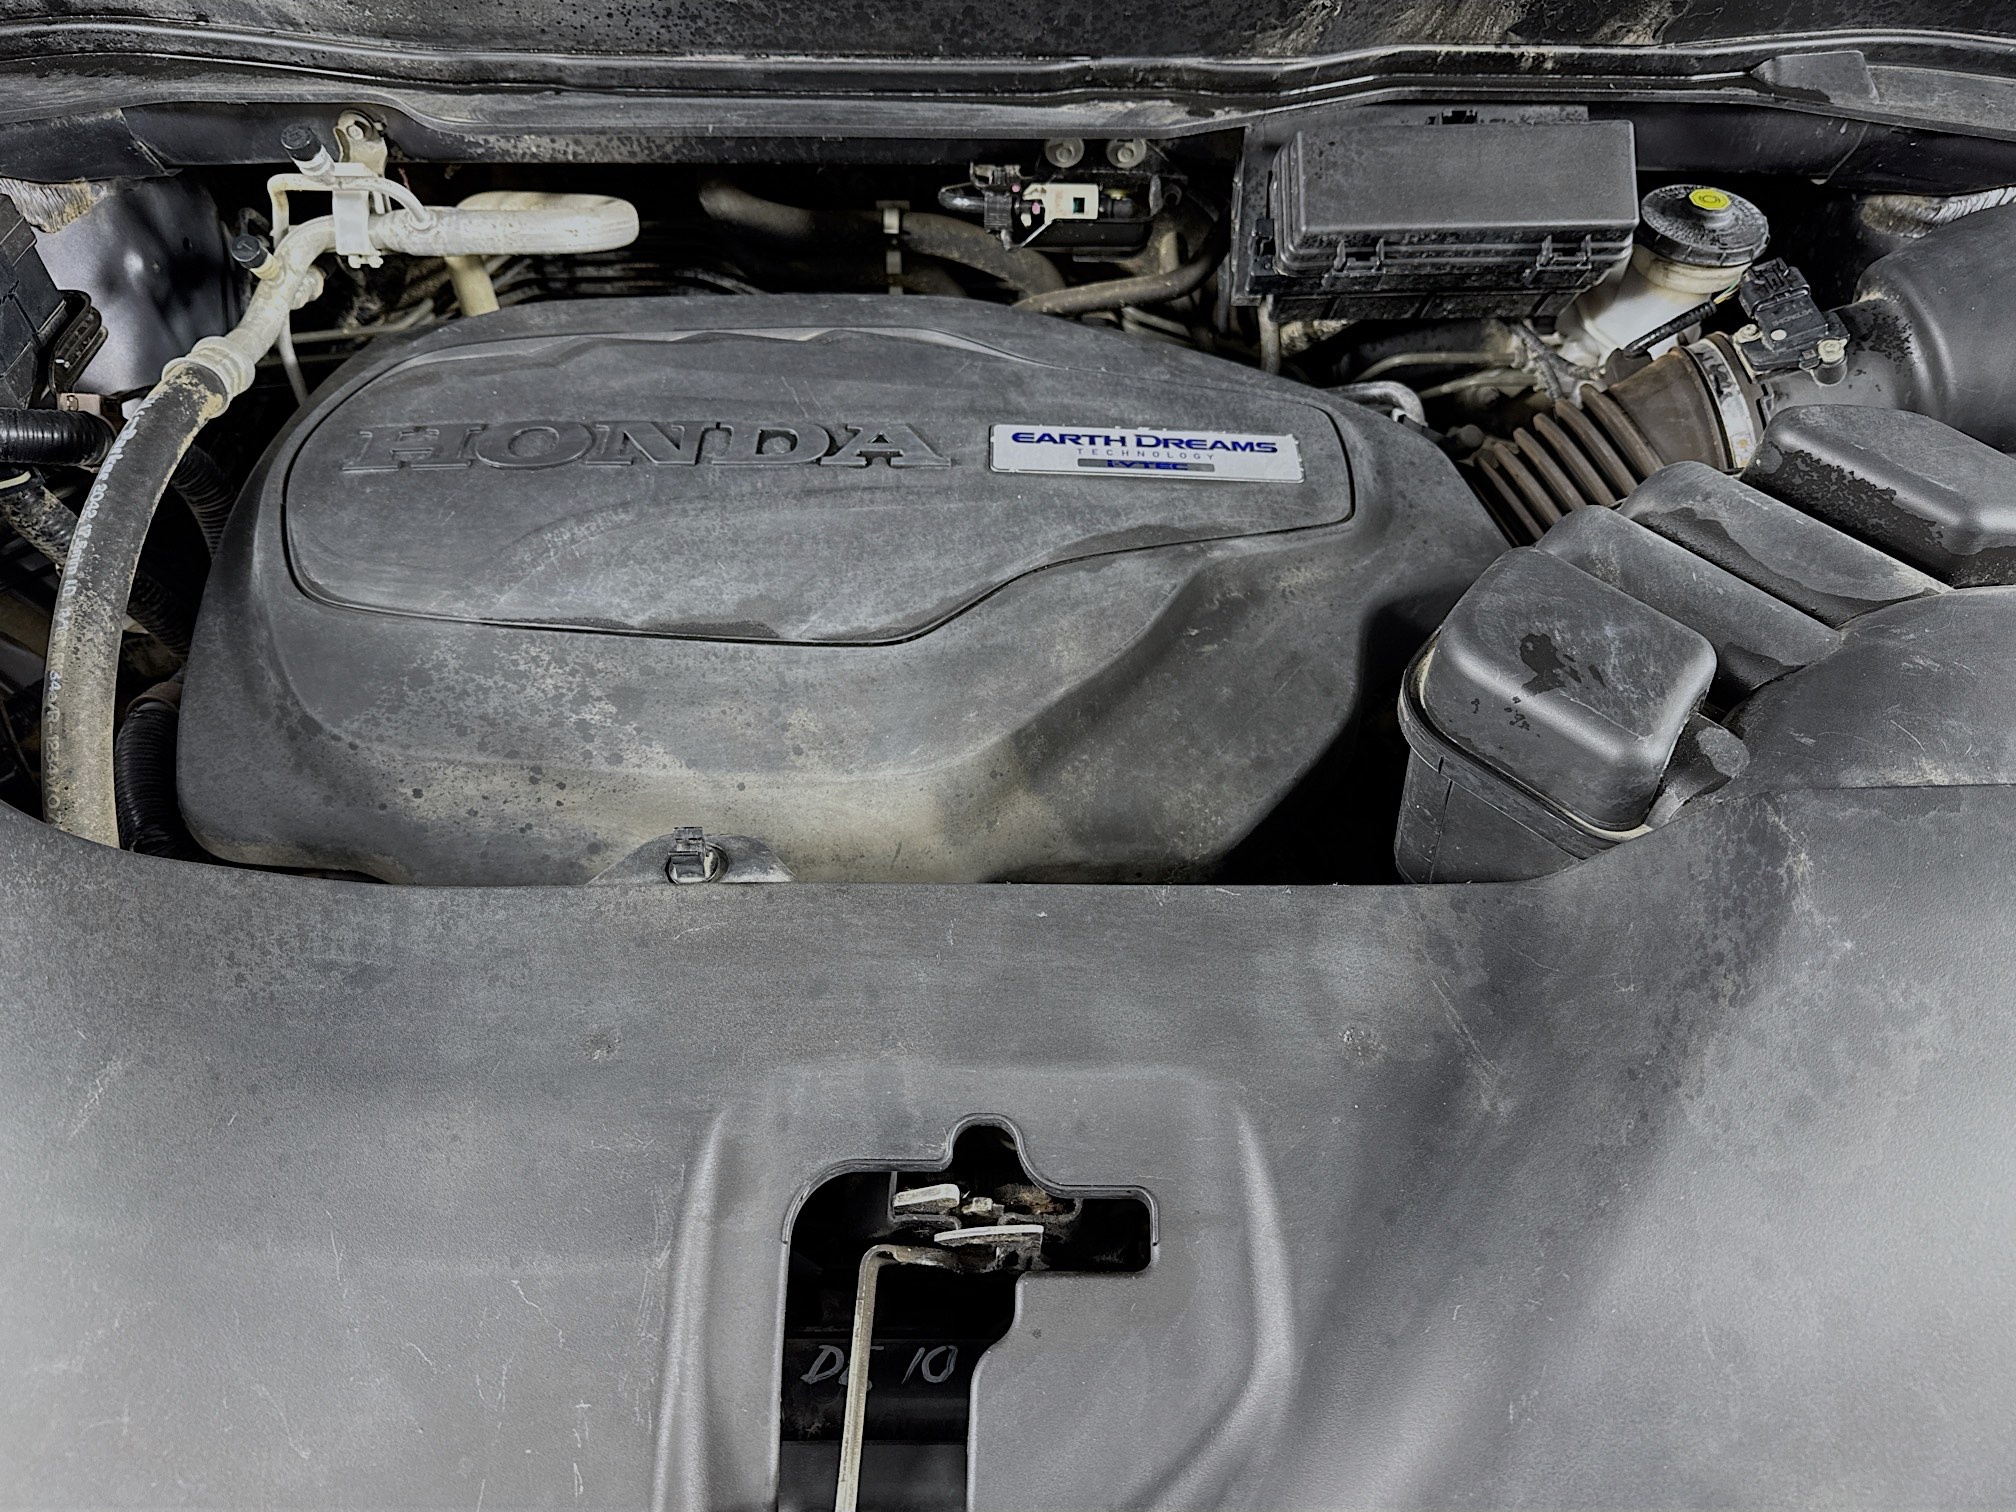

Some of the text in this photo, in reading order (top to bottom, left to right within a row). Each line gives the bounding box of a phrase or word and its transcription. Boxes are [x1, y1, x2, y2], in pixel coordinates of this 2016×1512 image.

[342, 422, 952, 471] HONDA
[1011, 432, 1278, 453] EARTH DREAMS
[1078, 448, 1215, 461] TECHNOLOGY
[901, 1344, 958, 1384] 10
